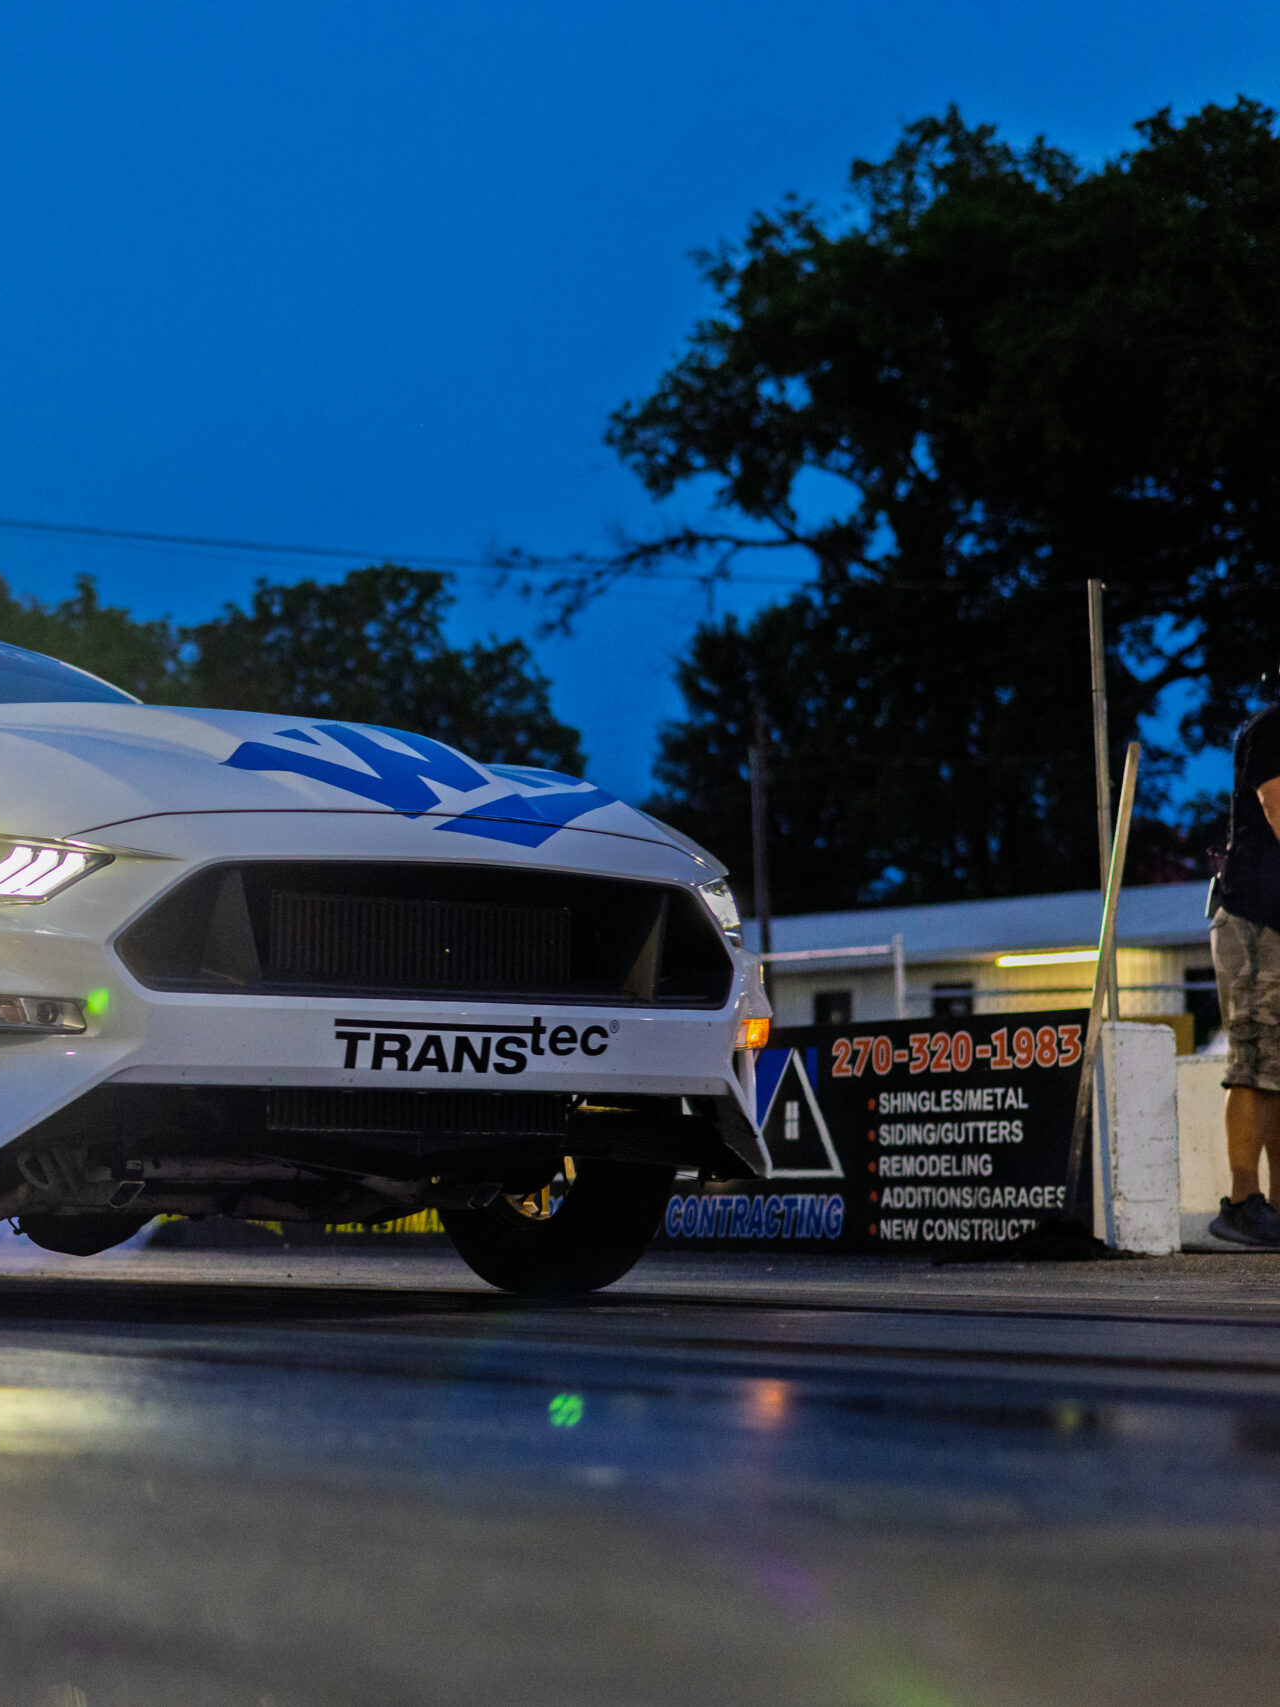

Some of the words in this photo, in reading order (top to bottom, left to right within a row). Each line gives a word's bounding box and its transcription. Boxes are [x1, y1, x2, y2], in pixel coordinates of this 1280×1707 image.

[832, 1024, 1082, 1077] 270-320-1983
[879, 1087, 1029, 1115] SHINGLES/METAL
[879, 1120, 1024, 1147] SIDING/GUTTERS
[879, 1154, 993, 1177] REMODELING
[880, 1185, 1066, 1209] ADDITIONS/GARAGES
[665, 1193, 844, 1239] CONTRACTING
[880, 1218, 917, 1241] NEW
